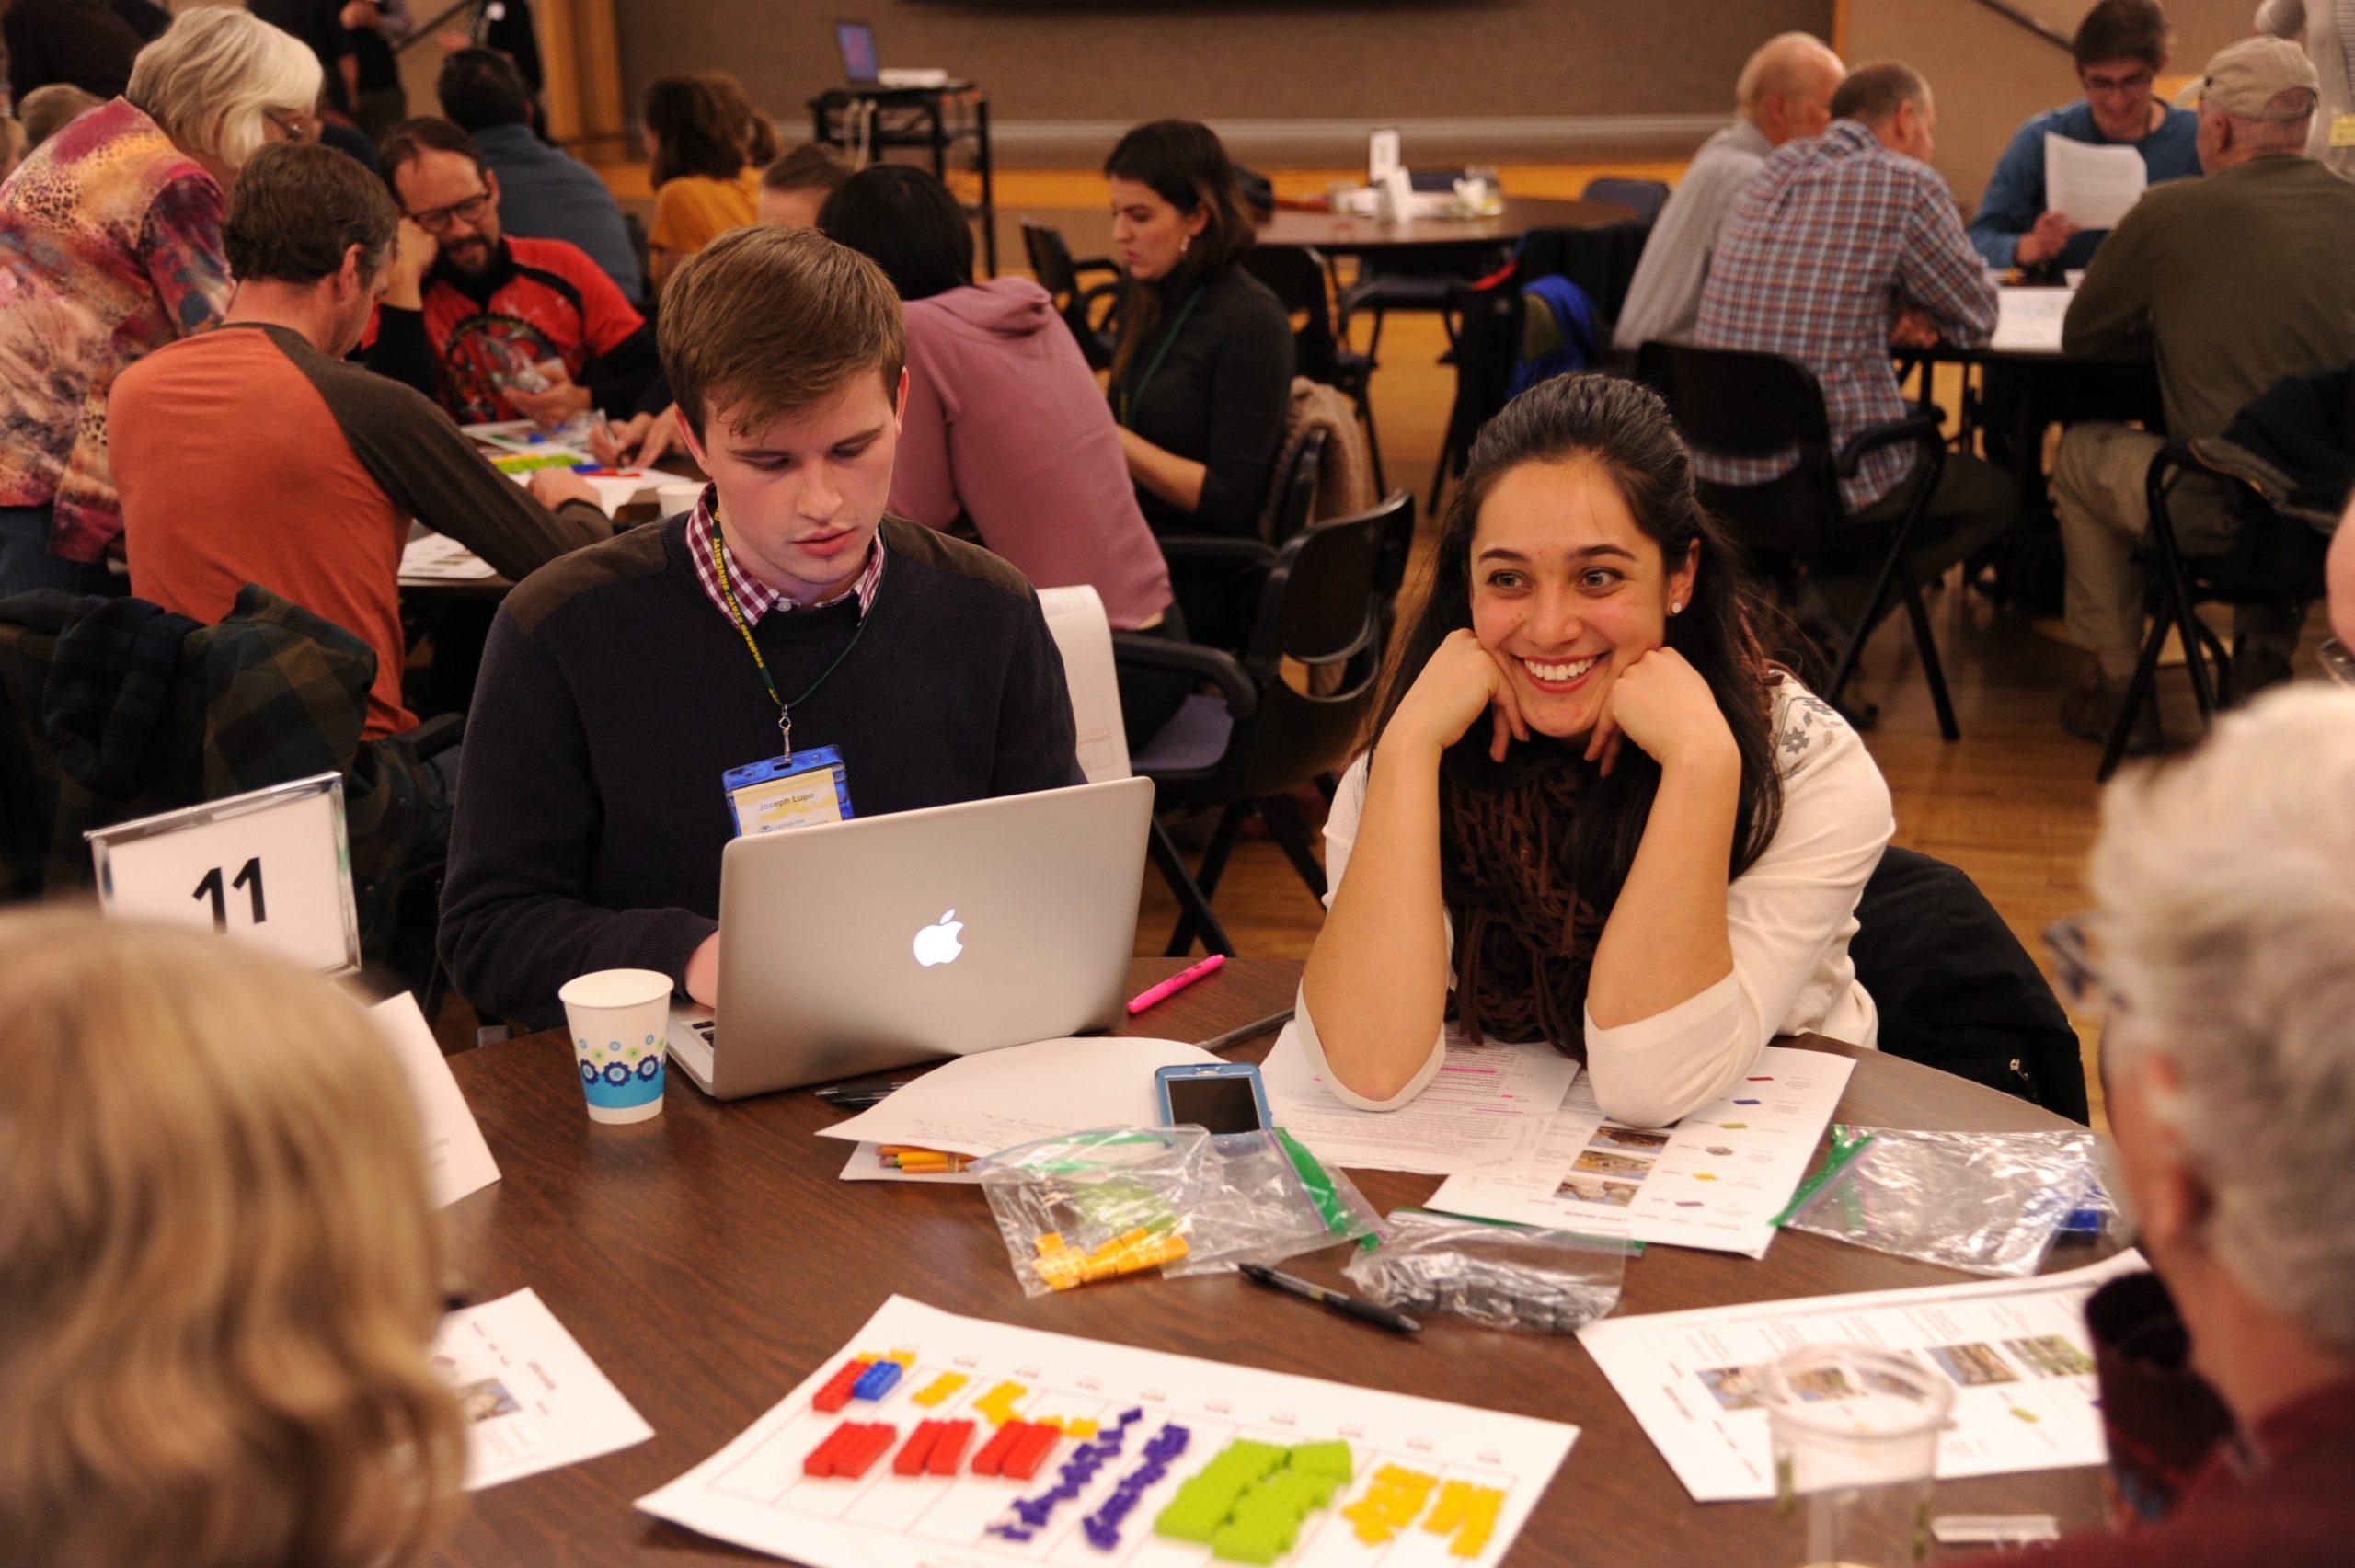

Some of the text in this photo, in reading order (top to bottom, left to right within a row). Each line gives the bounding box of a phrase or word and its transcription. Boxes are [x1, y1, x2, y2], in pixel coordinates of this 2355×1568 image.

[713, 538, 729, 591] UNIVERSITY
[727, 593, 743, 623] STATE
[741, 624, 764, 668] COLORADO
[759, 793, 814, 811] Joseph Lupo
[192, 857, 267, 933] 11
